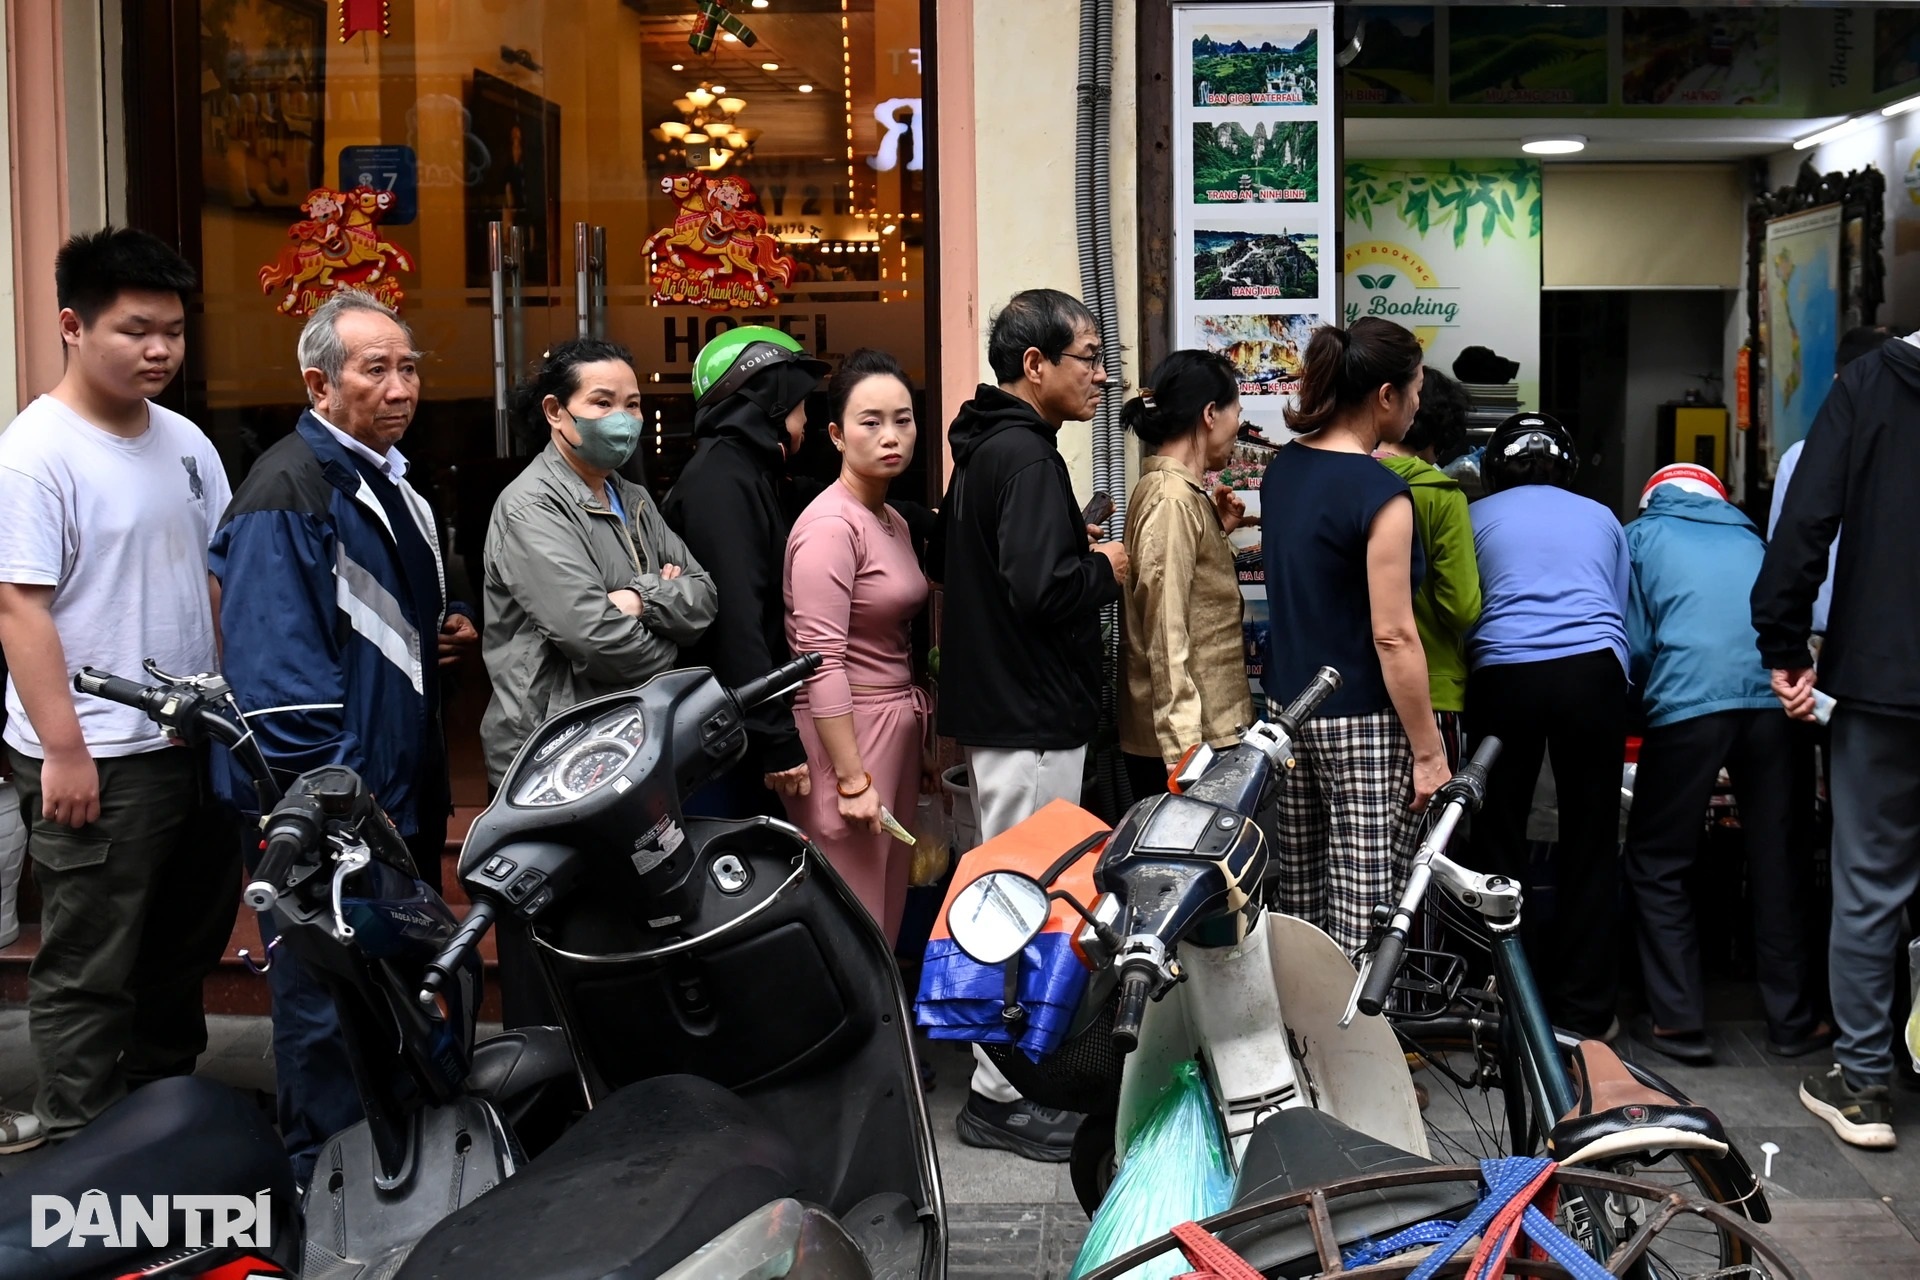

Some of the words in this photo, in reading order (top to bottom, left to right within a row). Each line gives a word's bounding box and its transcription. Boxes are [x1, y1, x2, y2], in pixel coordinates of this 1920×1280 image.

[1207, 93, 1228, 103] BAN
[1251, 92, 1302, 103] WATERFALL
[1207, 190, 1238, 200] TRANG
[1239, 190, 1253, 200] AN
[1260, 189, 1283, 199] NINH
[1284, 189, 1306, 199] BINH
[1371, 246, 1429, 281] BOOKING
[1232, 287, 1258, 296] HANG
[1259, 286, 1281, 296] MUA
[1368, 295, 1460, 322] Booking
[739, 348, 779, 372] ROBINS
[1241, 382, 1261, 392] NHA
[1268, 382, 1280, 392] KE
[1239, 570, 1253, 580] HA
[390, 911, 411, 922] YADEA
[411, 915, 430, 927] SPORT
